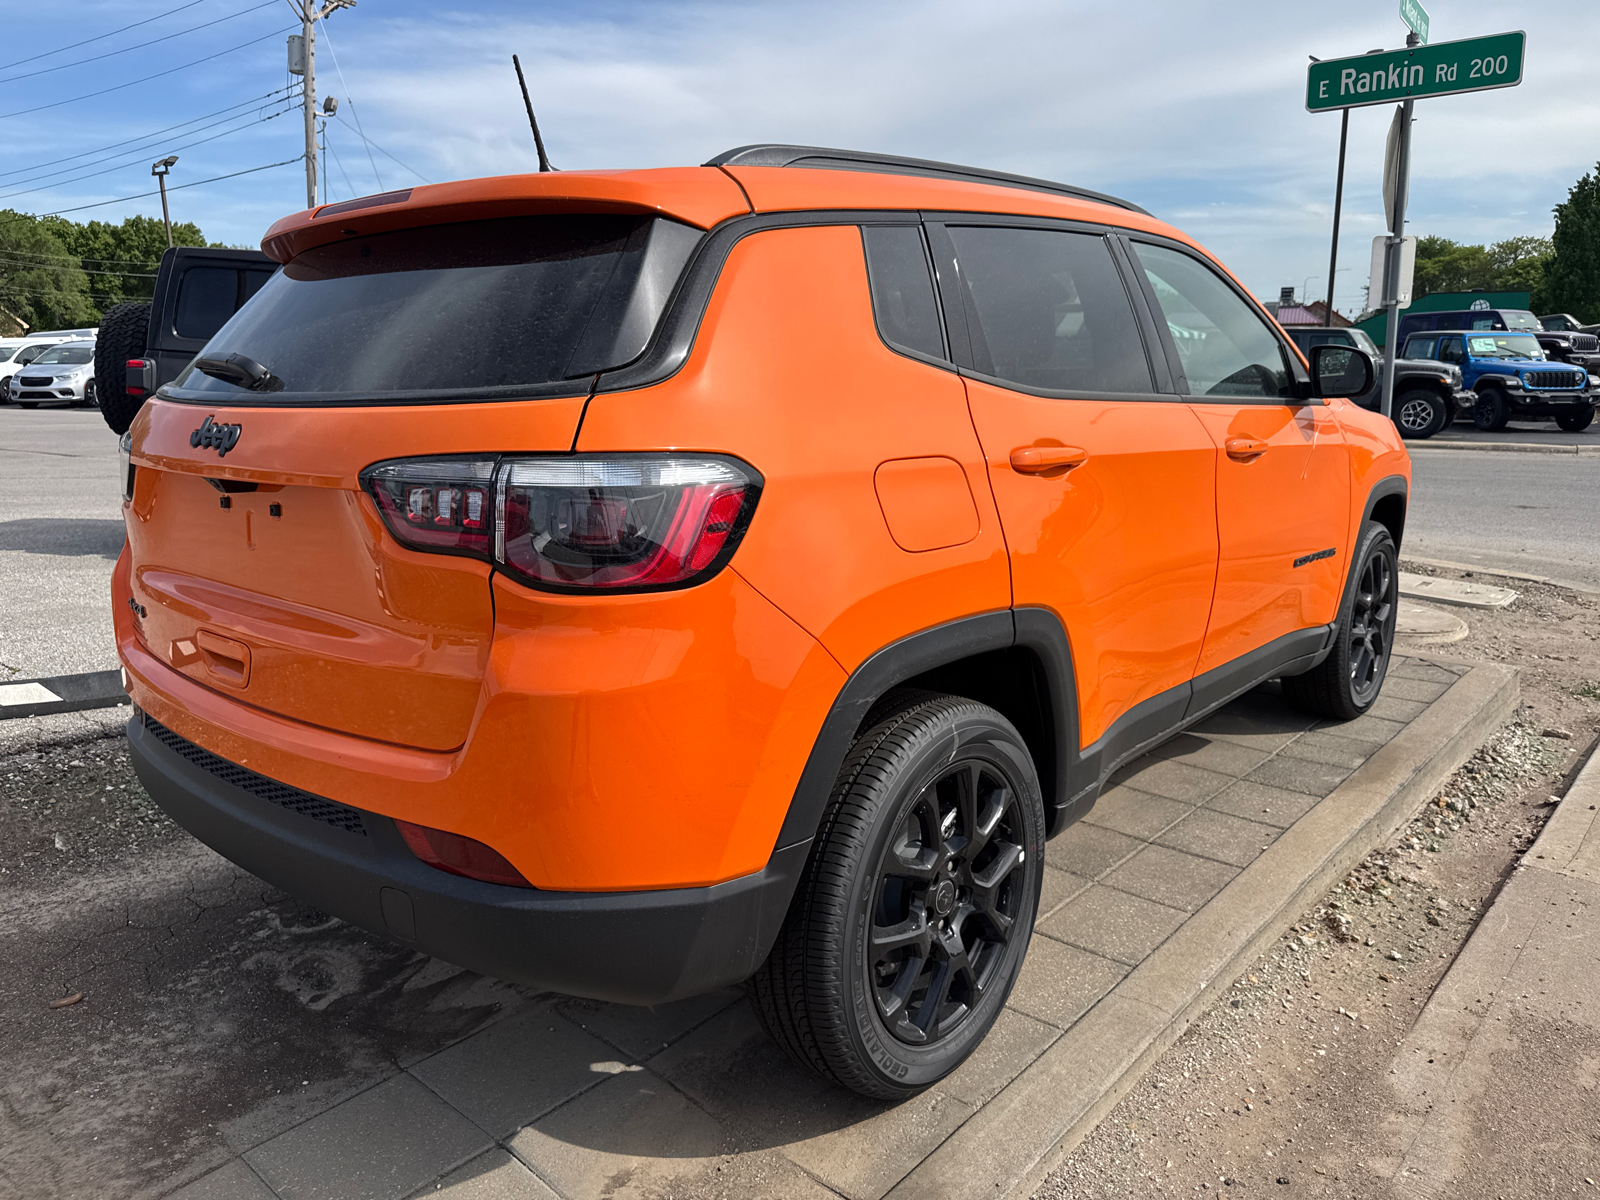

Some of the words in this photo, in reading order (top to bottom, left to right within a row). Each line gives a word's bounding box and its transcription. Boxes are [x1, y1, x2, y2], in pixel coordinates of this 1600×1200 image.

[1319, 80, 1329, 98] E
[1340, 61, 1424, 95] Rankin
[1435, 63, 1457, 83] Rd
[1469, 55, 1508, 78] 200
[190, 415, 242, 458] Jeep
